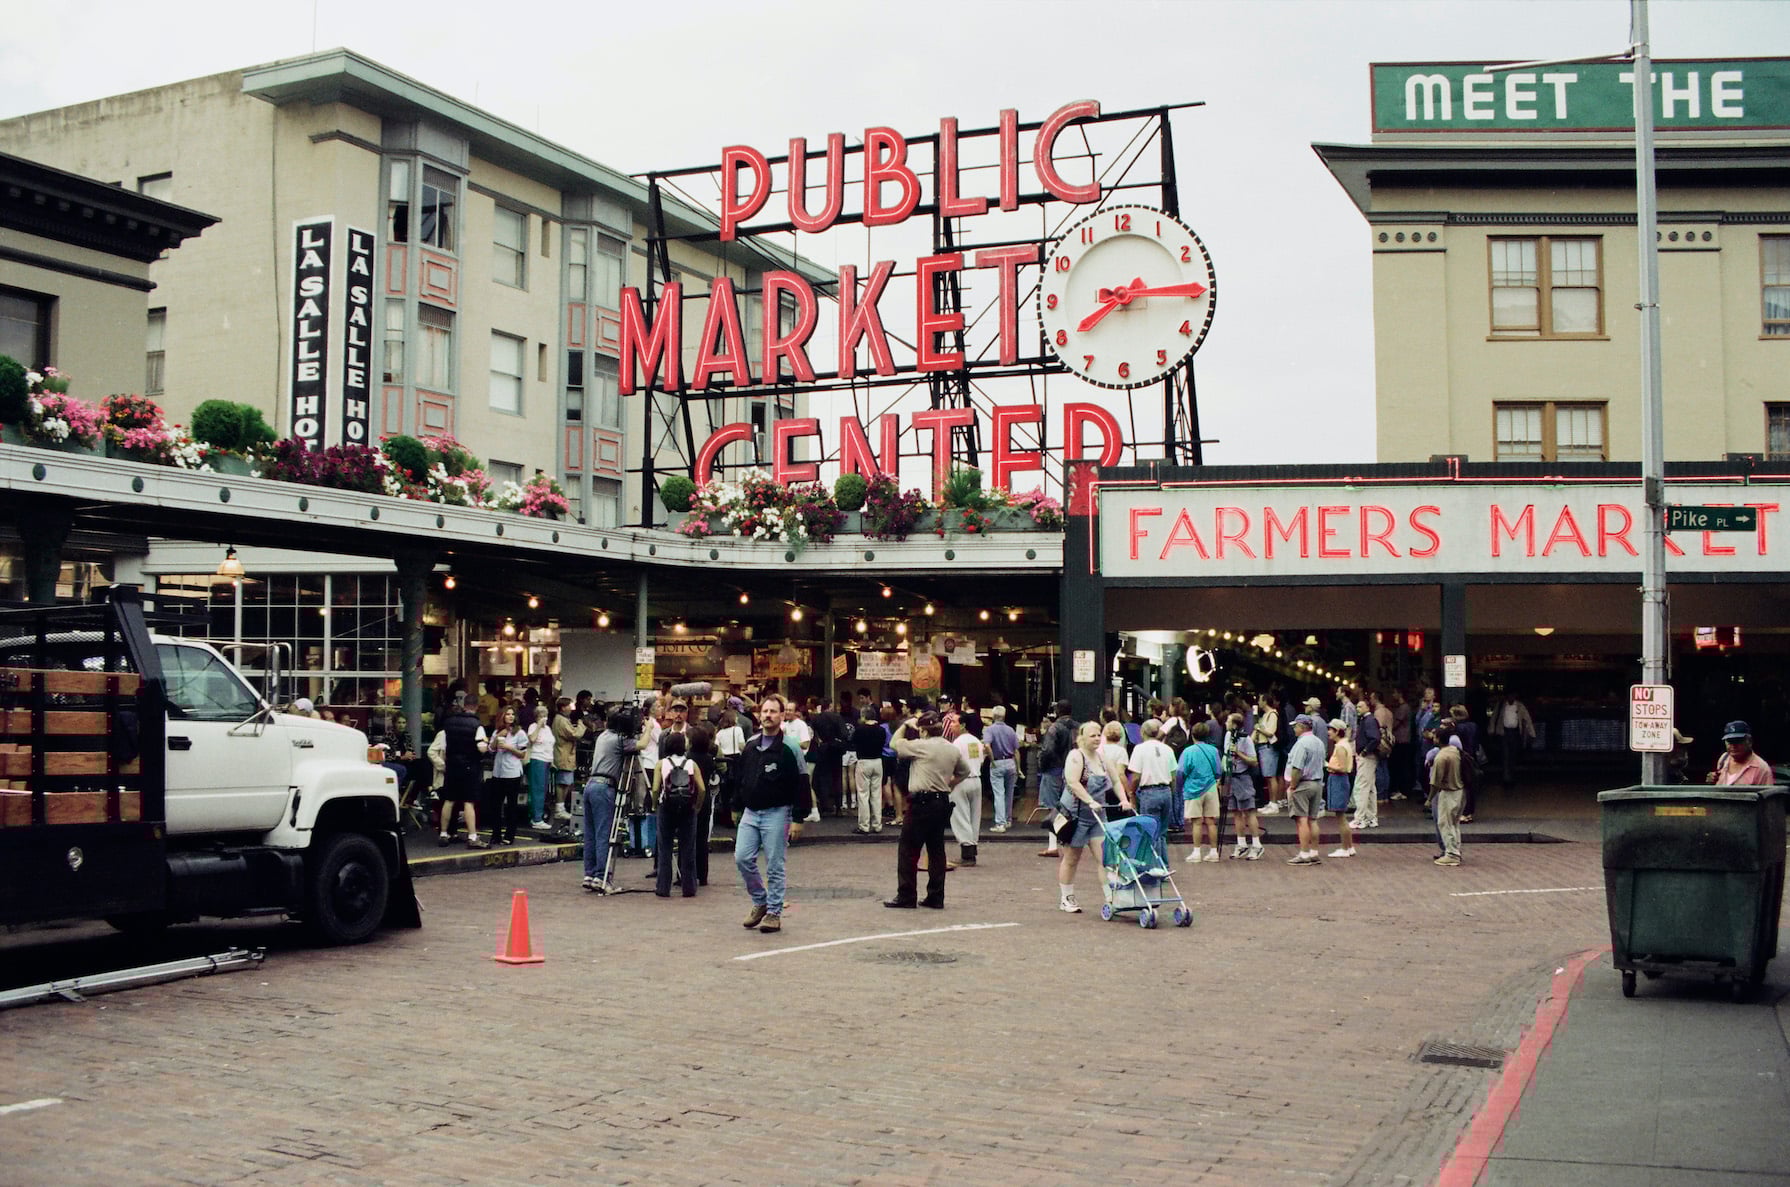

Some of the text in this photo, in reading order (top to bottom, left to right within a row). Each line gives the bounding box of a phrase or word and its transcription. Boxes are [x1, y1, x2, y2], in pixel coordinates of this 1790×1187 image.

[1405, 73, 1578, 120] MEET
[719, 100, 1101, 242] PUBLIC
[1114, 213, 1131, 231] 12
[1156, 221, 1161, 237] 1
[1081, 227, 1093, 244] 11
[299, 229, 324, 269] LA
[1180, 246, 1191, 262] 2
[1056, 256, 1070, 272] 10
[1047, 294, 1058, 309] 9
[619, 244, 1040, 396] MARKET
[1178, 320, 1192, 336] 4
[297, 276, 324, 382] SALLE
[346, 233, 369, 447] LA SALLE HO
[1056, 329, 1068, 346] 8
[1083, 355, 1094, 371] 7
[1156, 350, 1167, 365] 5
[1118, 362, 1130, 377] 6
[1672, 510, 1729, 528] Pike PL
[1129, 505, 1441, 560] FARMERS
[1634, 687, 1650, 700] NO
[1635, 704, 1668, 716] STOPS
[1635, 720, 1668, 729] TOW-AWAY
[1730, 725, 1736, 733] S
[1641, 731, 1661, 739] ZONE
